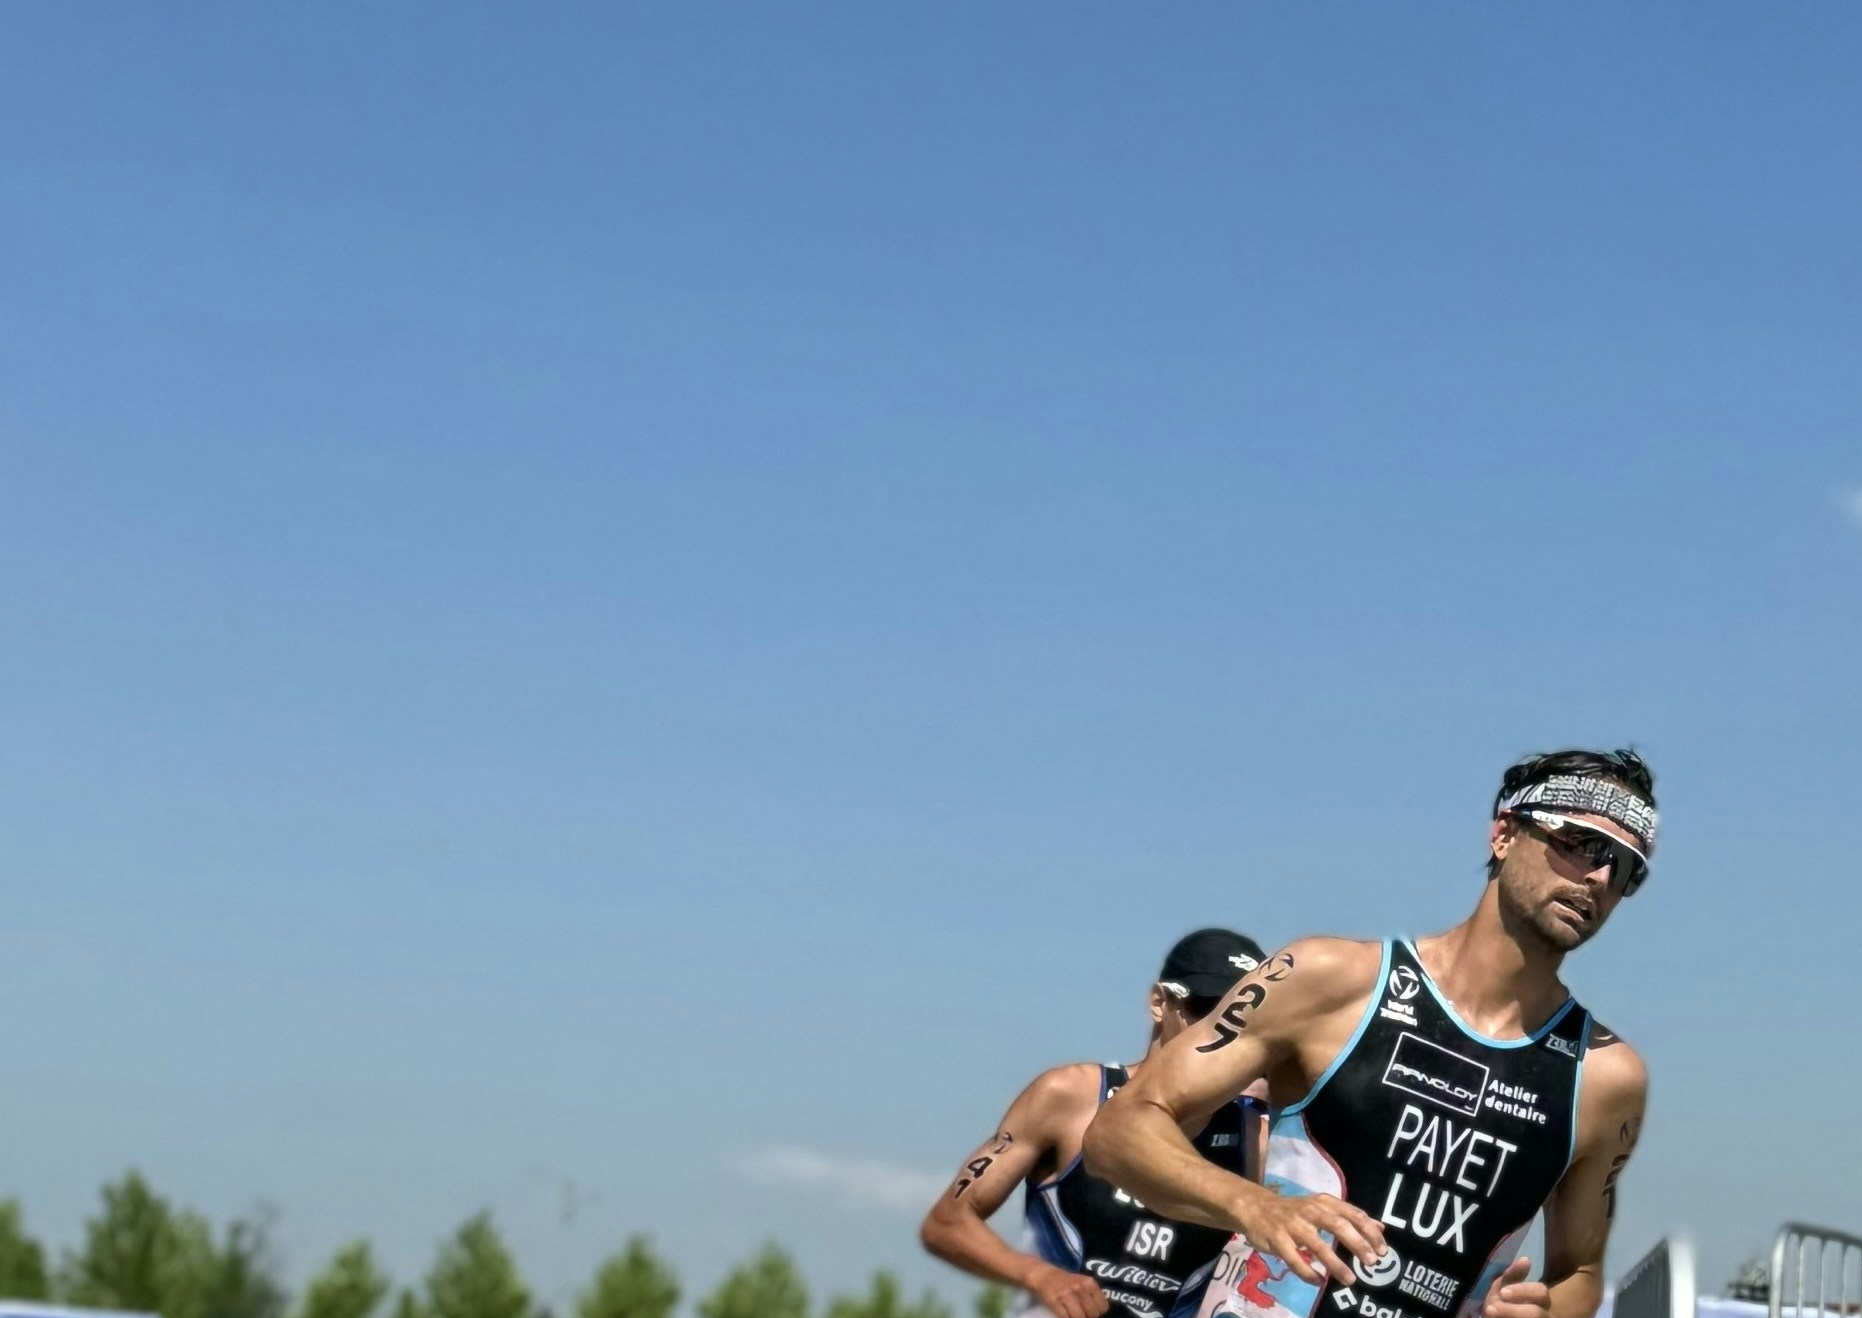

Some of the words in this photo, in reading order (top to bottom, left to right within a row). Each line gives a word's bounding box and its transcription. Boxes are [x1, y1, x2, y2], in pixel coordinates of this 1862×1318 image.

[1195, 983, 1266, 1054] 27
[1485, 1095, 1547, 1125] dentaire
[1488, 1079, 1538, 1104] Atelier
[1387, 1104, 1518, 1197] PAYET
[1381, 1173, 1480, 1253] LUX
[1126, 1221, 1174, 1260] ISR
[1404, 1261, 1459, 1298] LOTERIE
[1101, 1288, 1154, 1311] aucony
